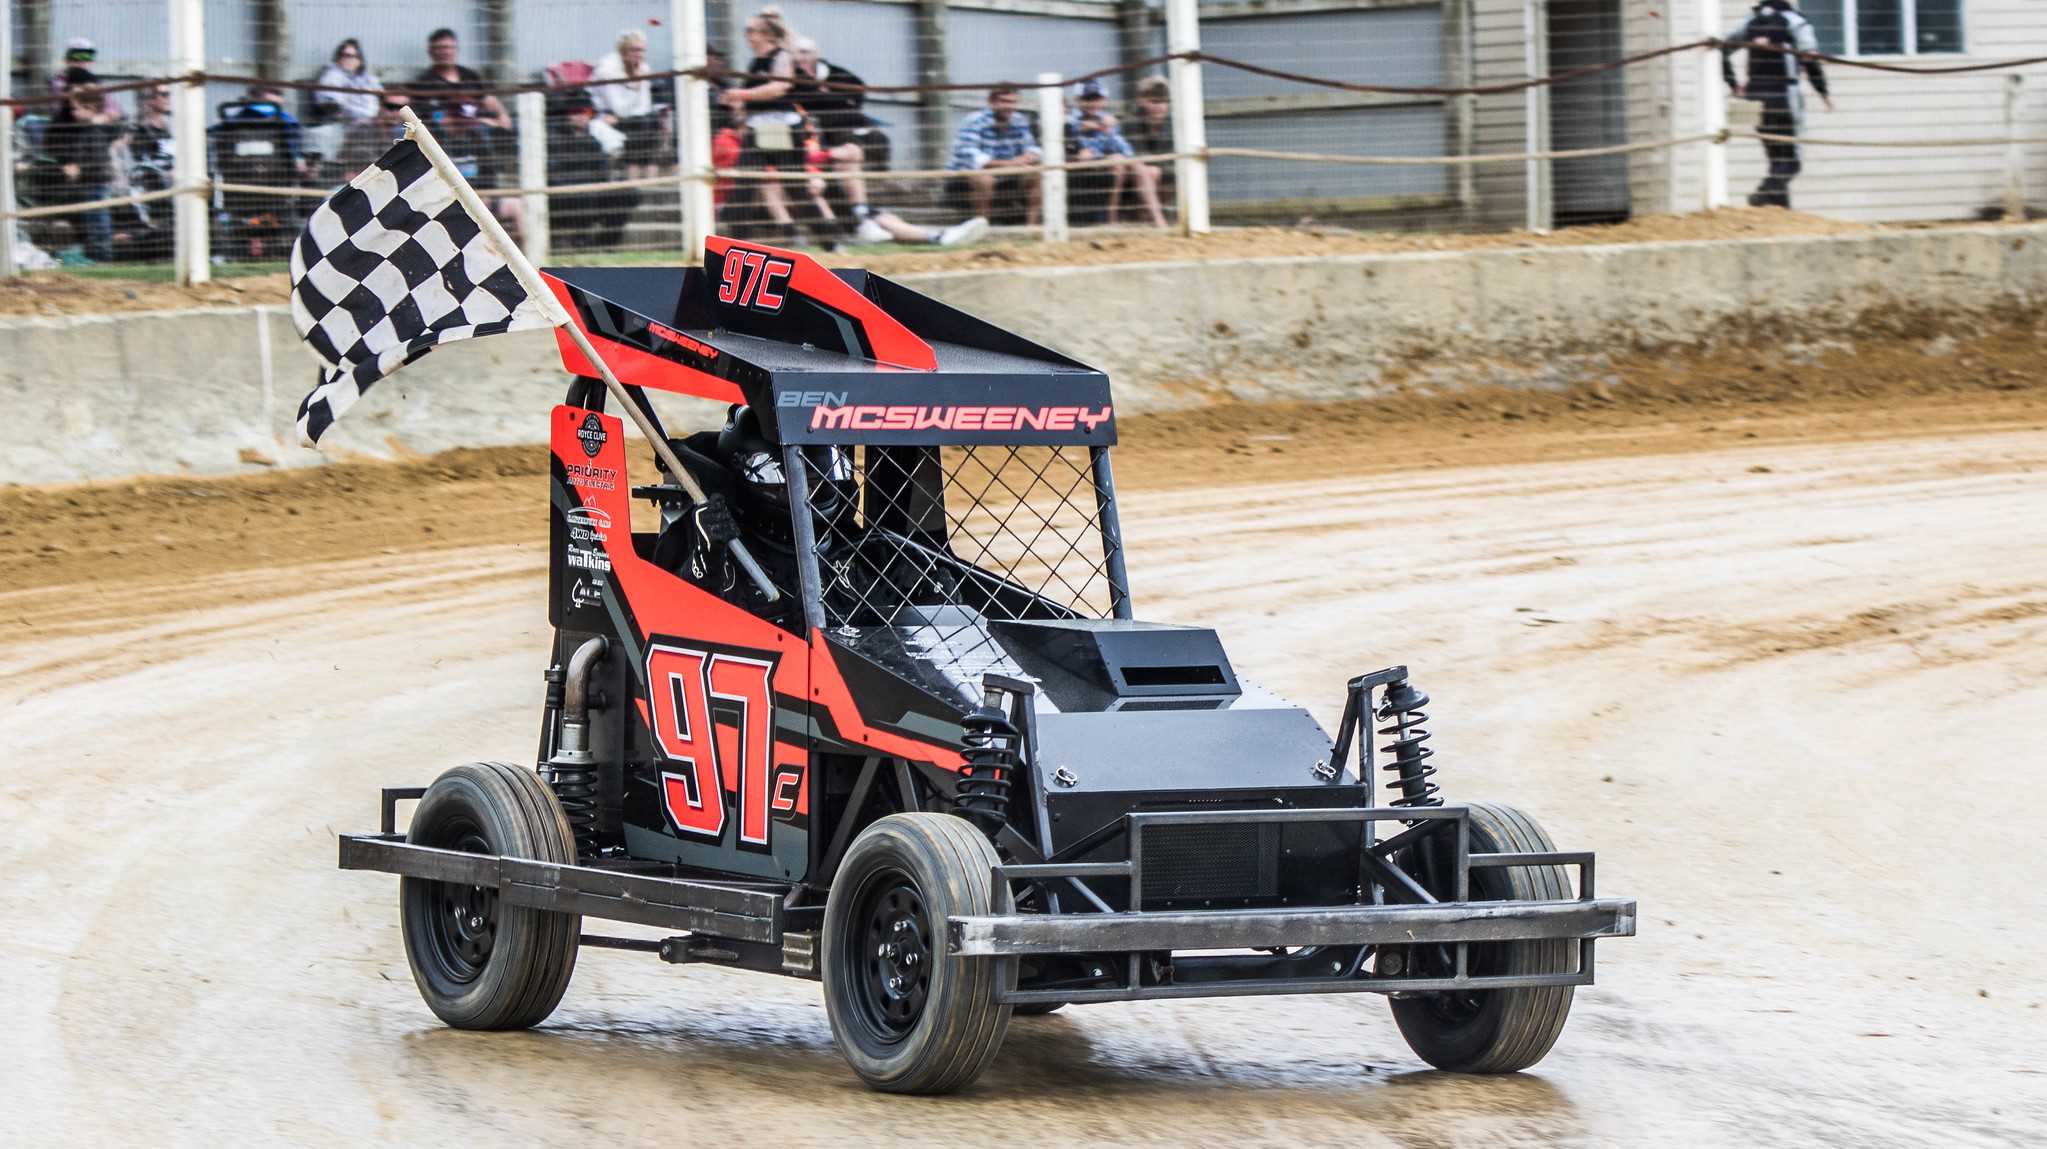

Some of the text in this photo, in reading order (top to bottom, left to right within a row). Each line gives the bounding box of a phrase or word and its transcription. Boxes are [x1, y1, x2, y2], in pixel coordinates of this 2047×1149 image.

[718, 248, 792, 310] 97C
[777, 391, 849, 408] BEN
[810, 405, 1112, 431] MCSWEENEY
[577, 429, 593, 439] ROYCE
[567, 464, 617, 480] PRIORITY
[570, 527, 590, 540] 4WD
